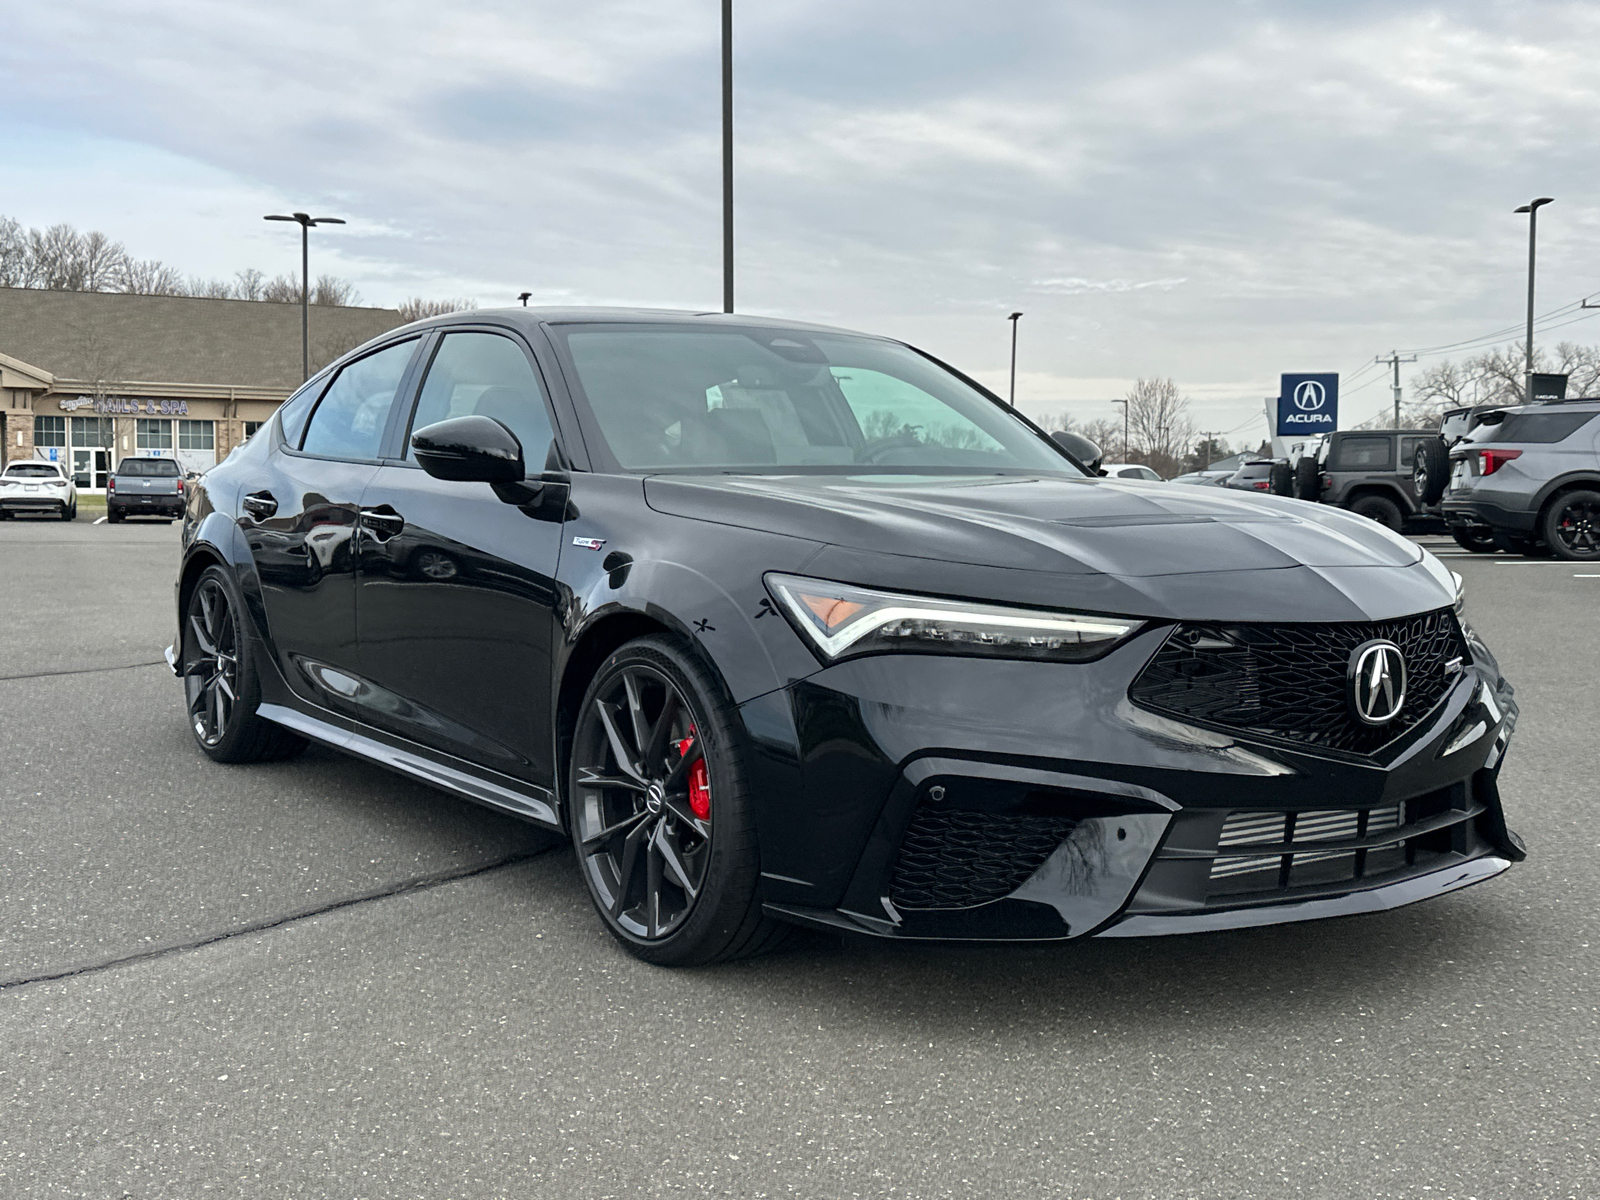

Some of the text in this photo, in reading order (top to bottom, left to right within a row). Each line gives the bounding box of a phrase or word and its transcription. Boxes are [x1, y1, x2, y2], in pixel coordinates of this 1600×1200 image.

[94, 398, 140, 414] NAILS
[161, 400, 189, 415] SPA
[1285, 414, 1333, 423] ACURA
